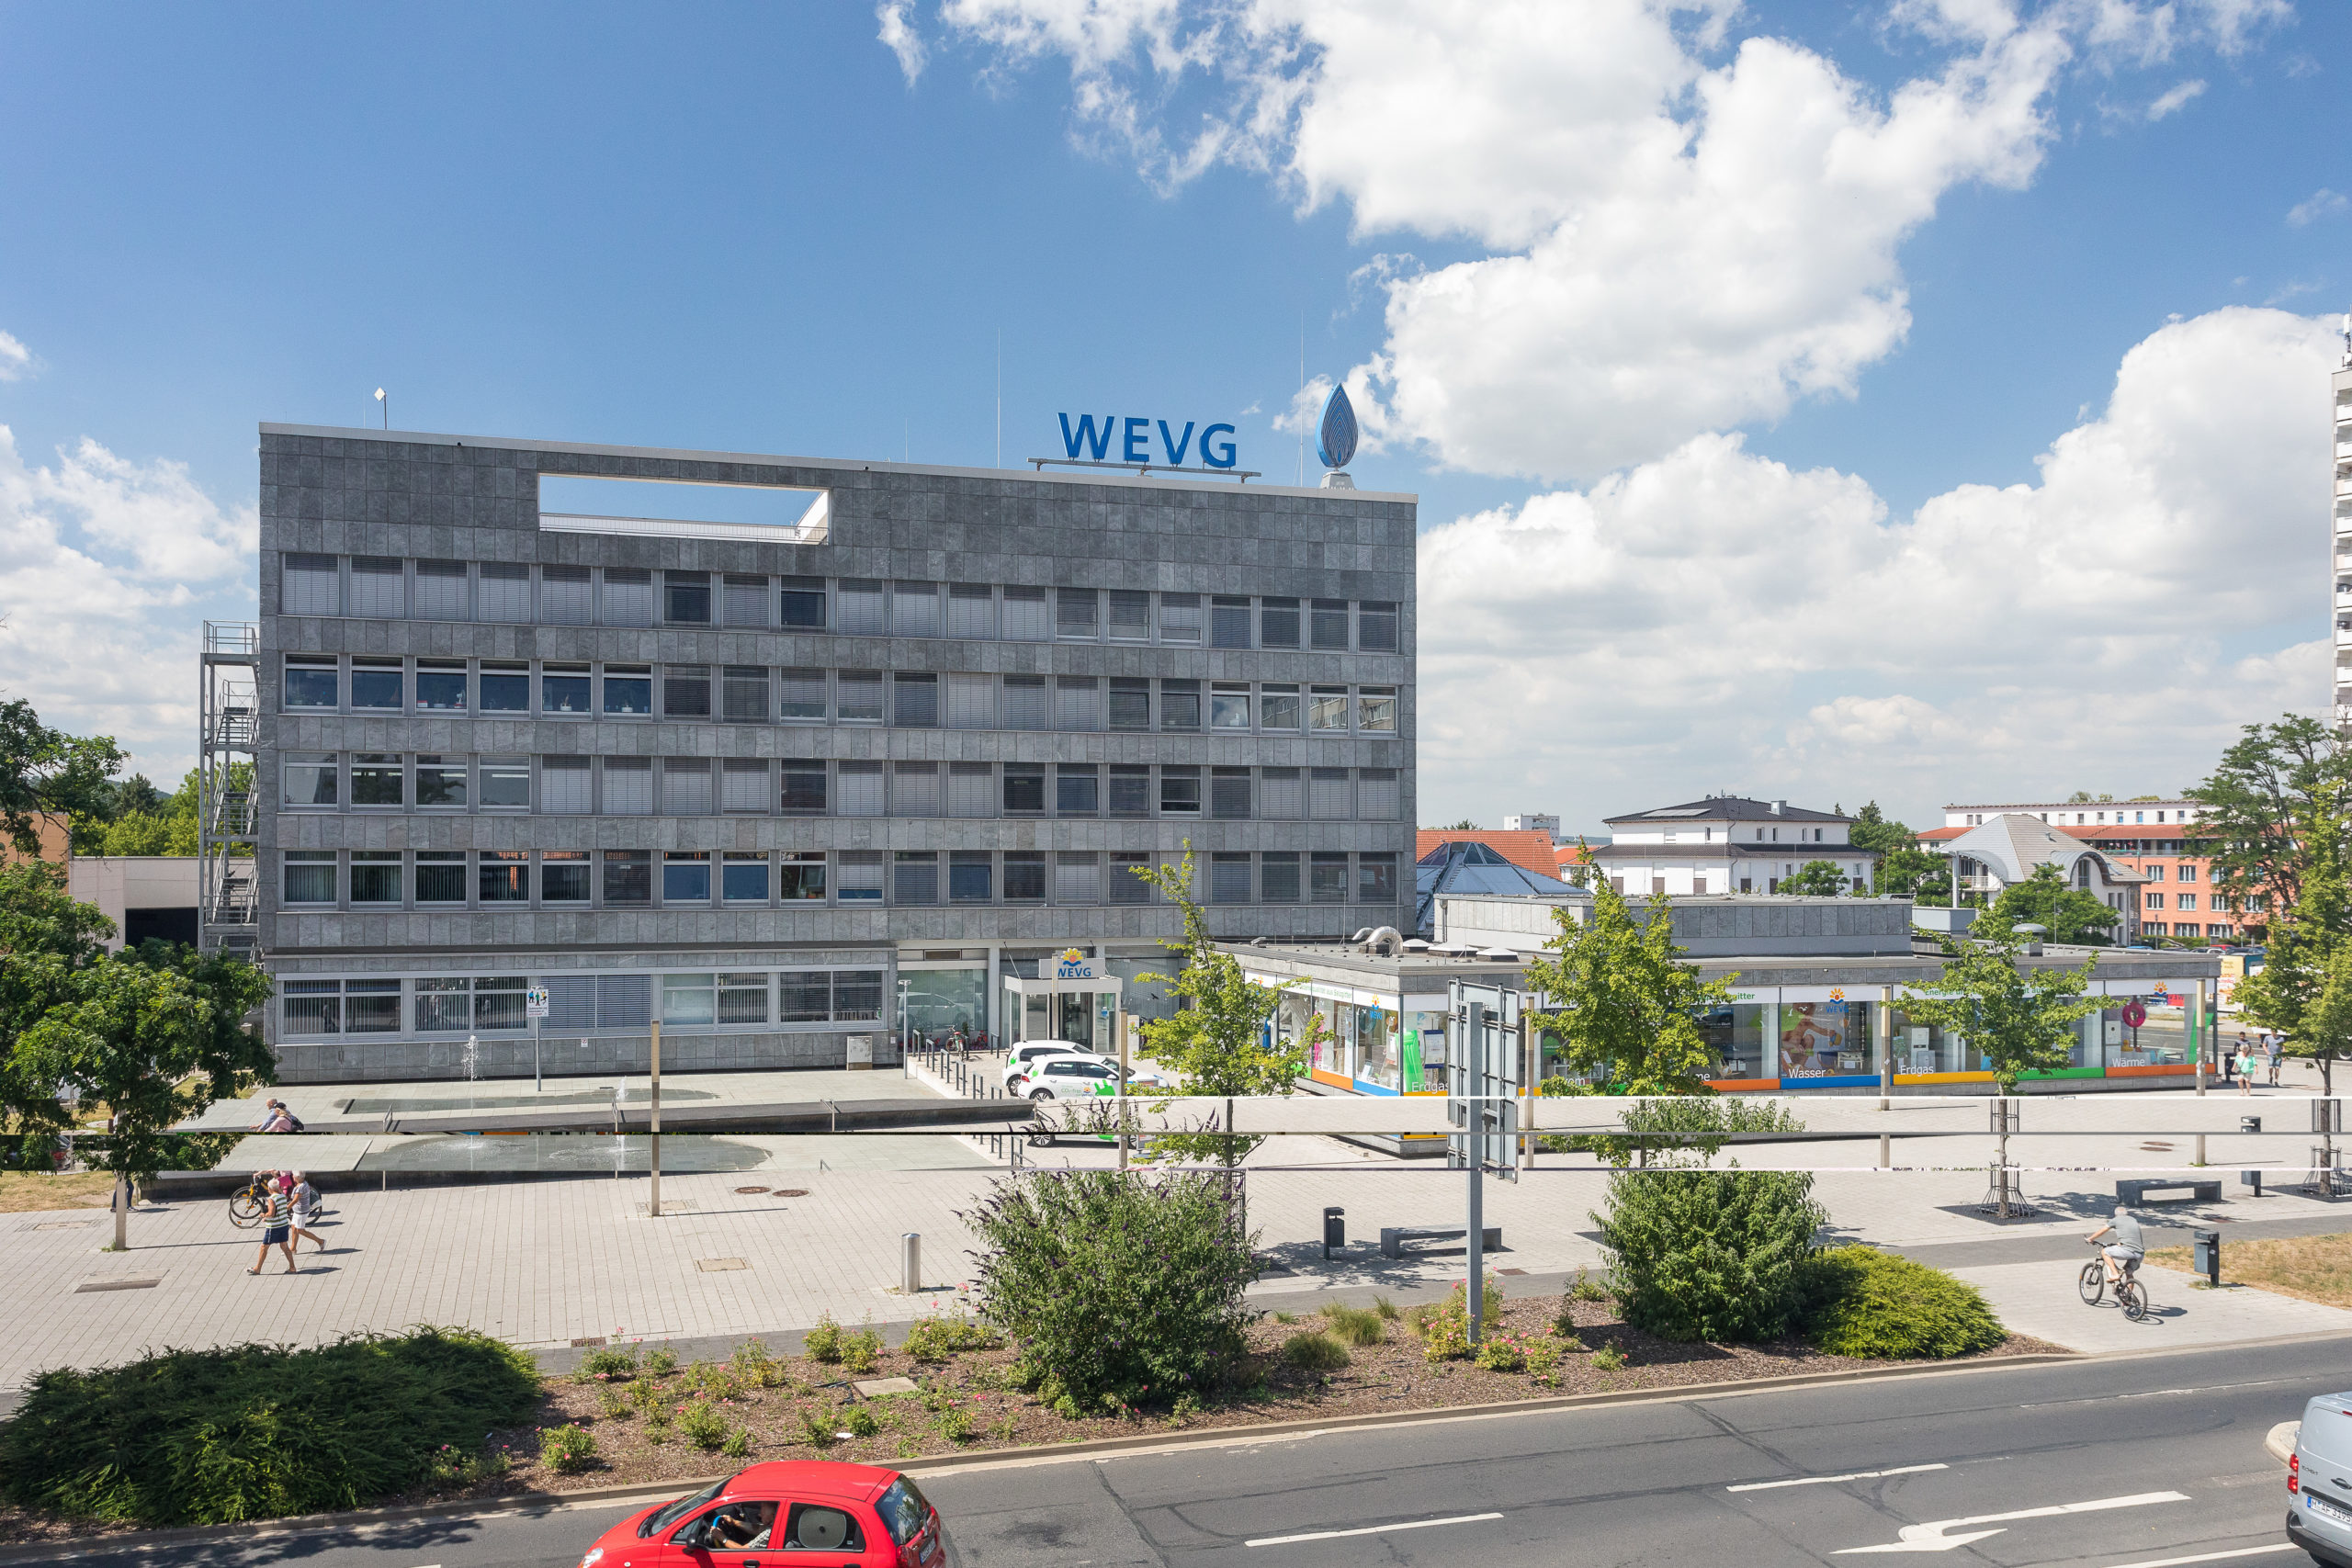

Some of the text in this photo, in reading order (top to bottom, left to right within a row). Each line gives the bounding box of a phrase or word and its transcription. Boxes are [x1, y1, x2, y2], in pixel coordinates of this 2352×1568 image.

[1057, 412, 1237, 468] WEVG
[1825, 1005, 1849, 1014] WEVG
[2111, 1057, 2145, 1068] Wärme
[1788, 1068, 1826, 1078] Wasser
[1899, 1064, 1934, 1076] Erdgas
[2332, 1507, 2351, 1523] 3195
